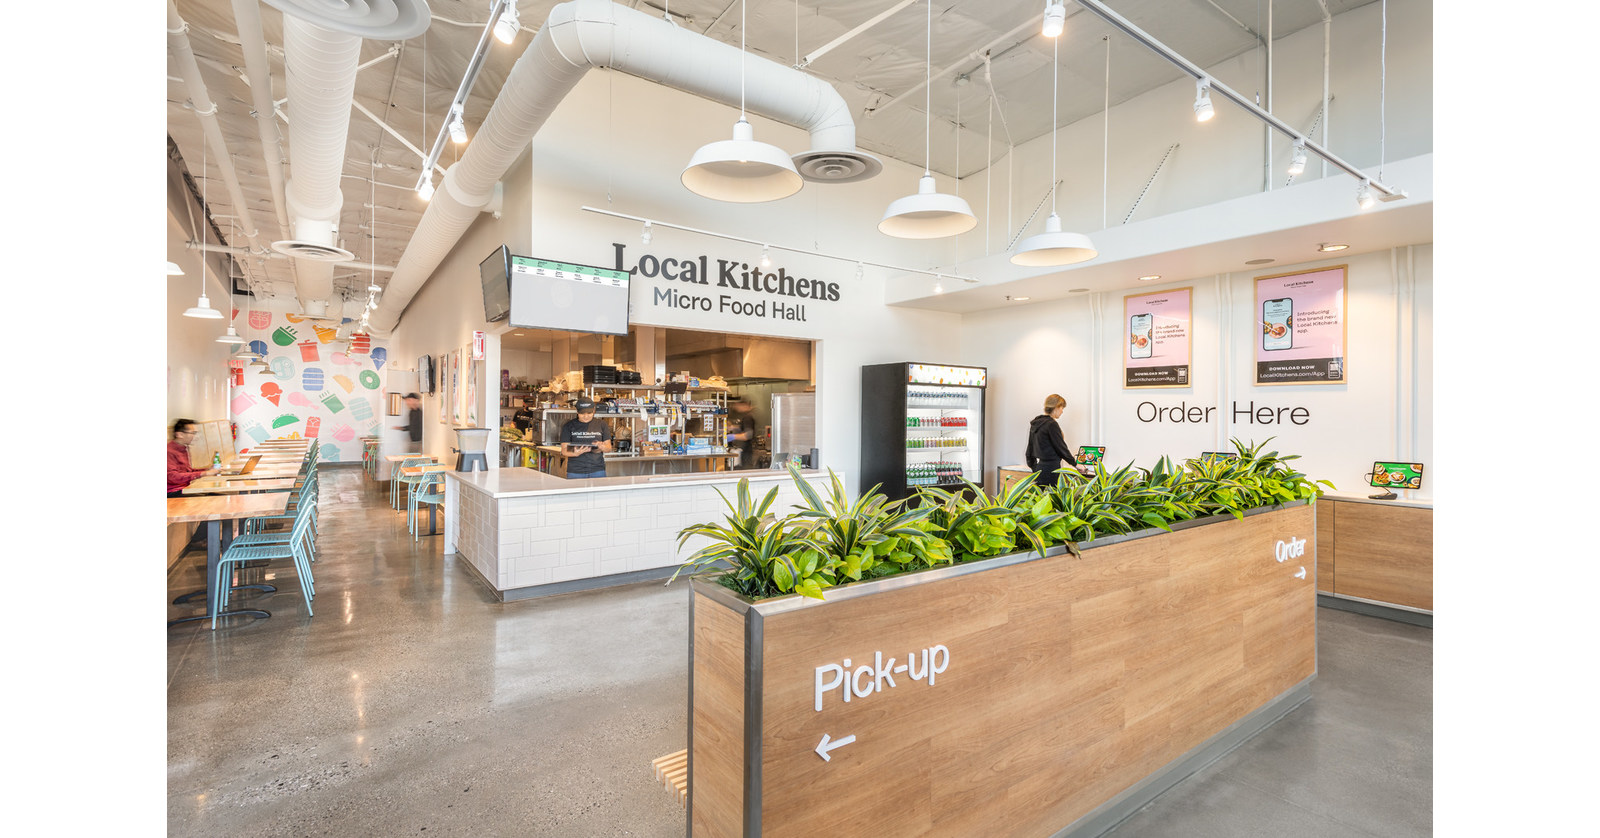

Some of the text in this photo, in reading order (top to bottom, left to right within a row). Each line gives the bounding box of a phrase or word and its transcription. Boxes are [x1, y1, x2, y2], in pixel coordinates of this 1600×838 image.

[612, 242, 841, 302] Local Kitchens
[653, 286, 807, 322] Micro Food Hall
[1259, 371, 1326, 379] LocalKitchens.com/App
[1136, 400, 1310, 426] Order Here
[1275, 536, 1307, 563] Order
[814, 644, 950, 712] Pick-up
